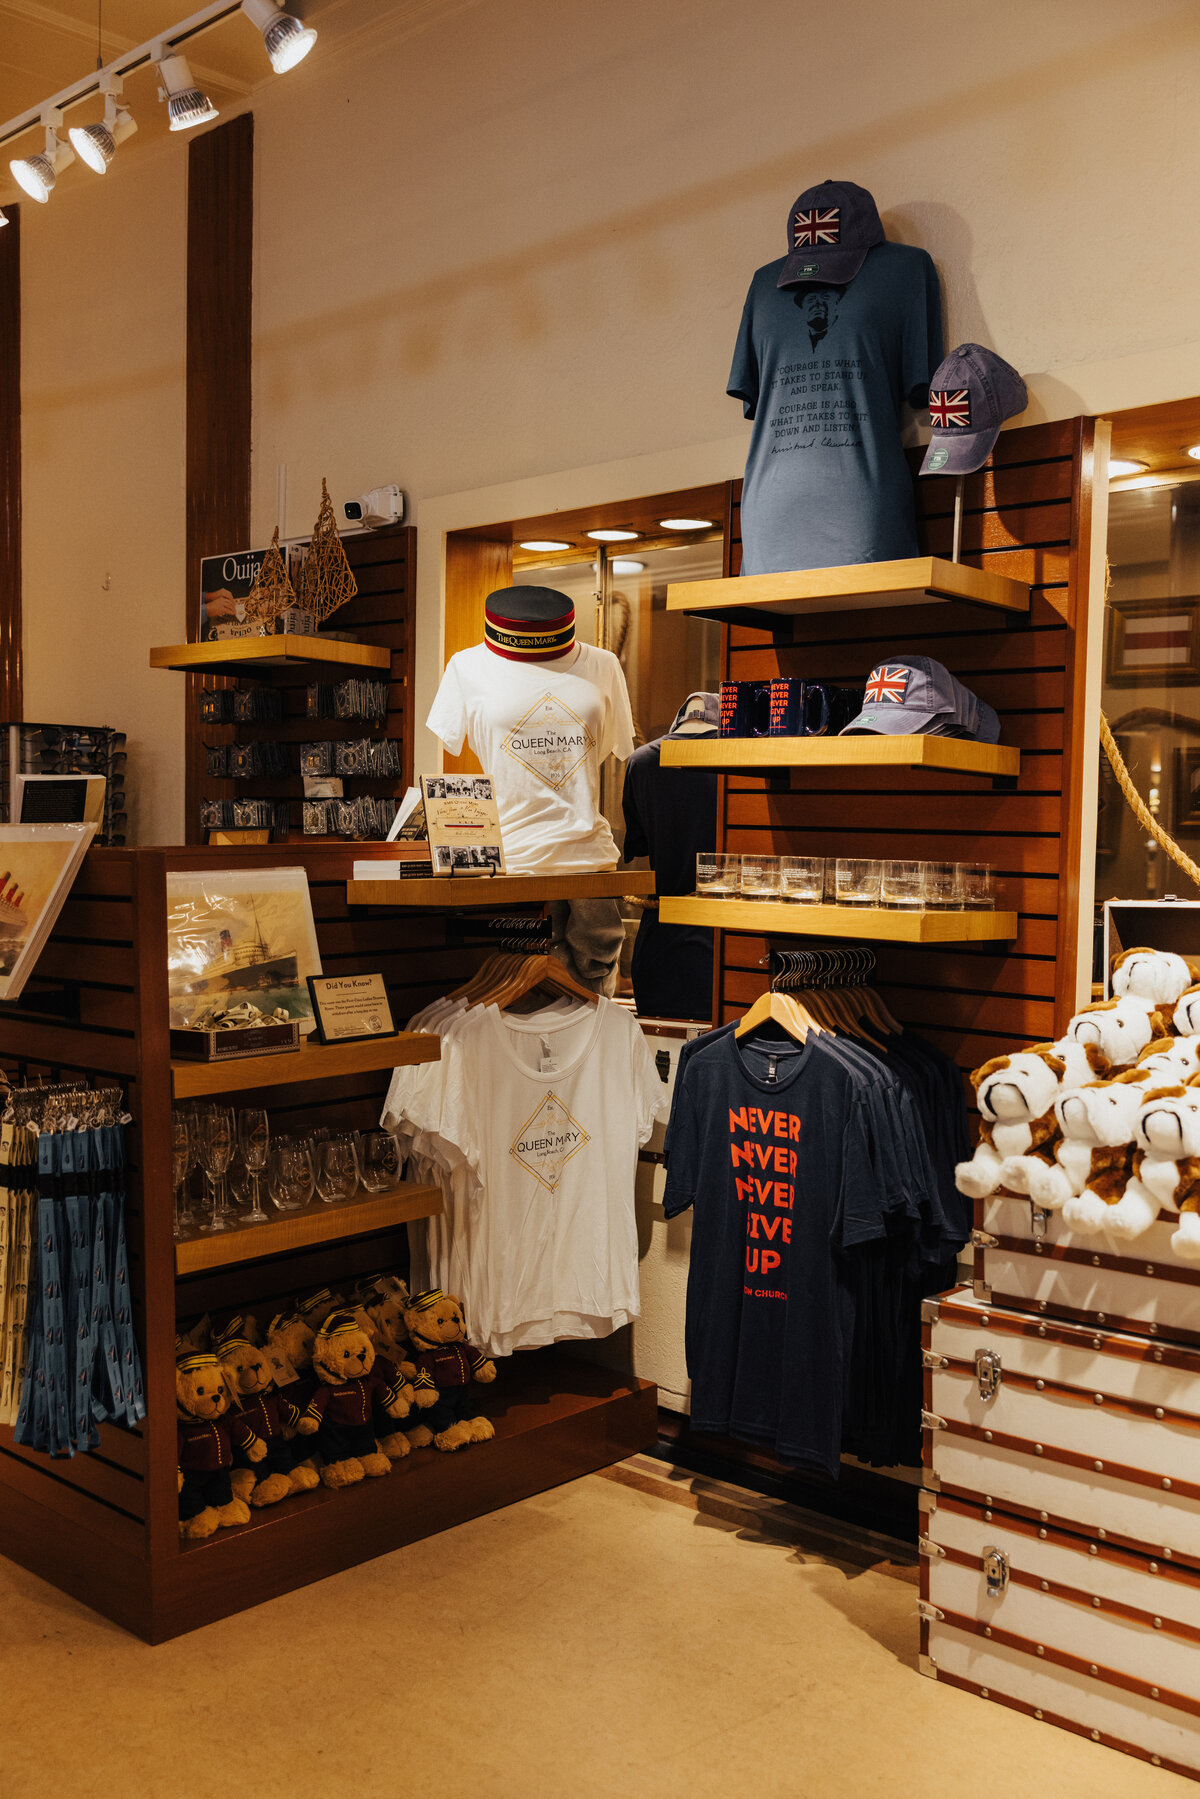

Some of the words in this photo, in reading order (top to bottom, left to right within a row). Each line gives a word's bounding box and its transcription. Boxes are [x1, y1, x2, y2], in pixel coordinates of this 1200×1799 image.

[822, 360, 830, 368] IS
[834, 360, 862, 368] WHAT
[780, 374, 806, 386] TAKES
[810, 372, 820, 380] TO
[824, 372, 854, 380] STAND
[790, 386, 808, 396] AND
[811, 383, 841, 392] SPEAK.
[780, 402, 818, 414] COURAGE
[834, 400, 856, 408] ALSO
[770, 417, 794, 428] WHAT
[808, 412, 835, 420] TAKES
[775, 427, 800, 438] DOWN
[803, 424, 820, 434] AND
[222, 555, 260, 587] Ouija
[510, 636, 534, 646] QUEEN
[512, 737, 554, 750] QUEEN
[557, 736, 590, 747] MARY
[352, 979, 372, 987] Know?
[729, 1106, 801, 1142] NEVER
[517, 1138, 552, 1152] QUEEN
[556, 1132, 580, 1146] MRY
[730, 1140, 797, 1178] NEVER
[747, 1212, 792, 1244] IVE
[746, 1246, 781, 1274] UP
